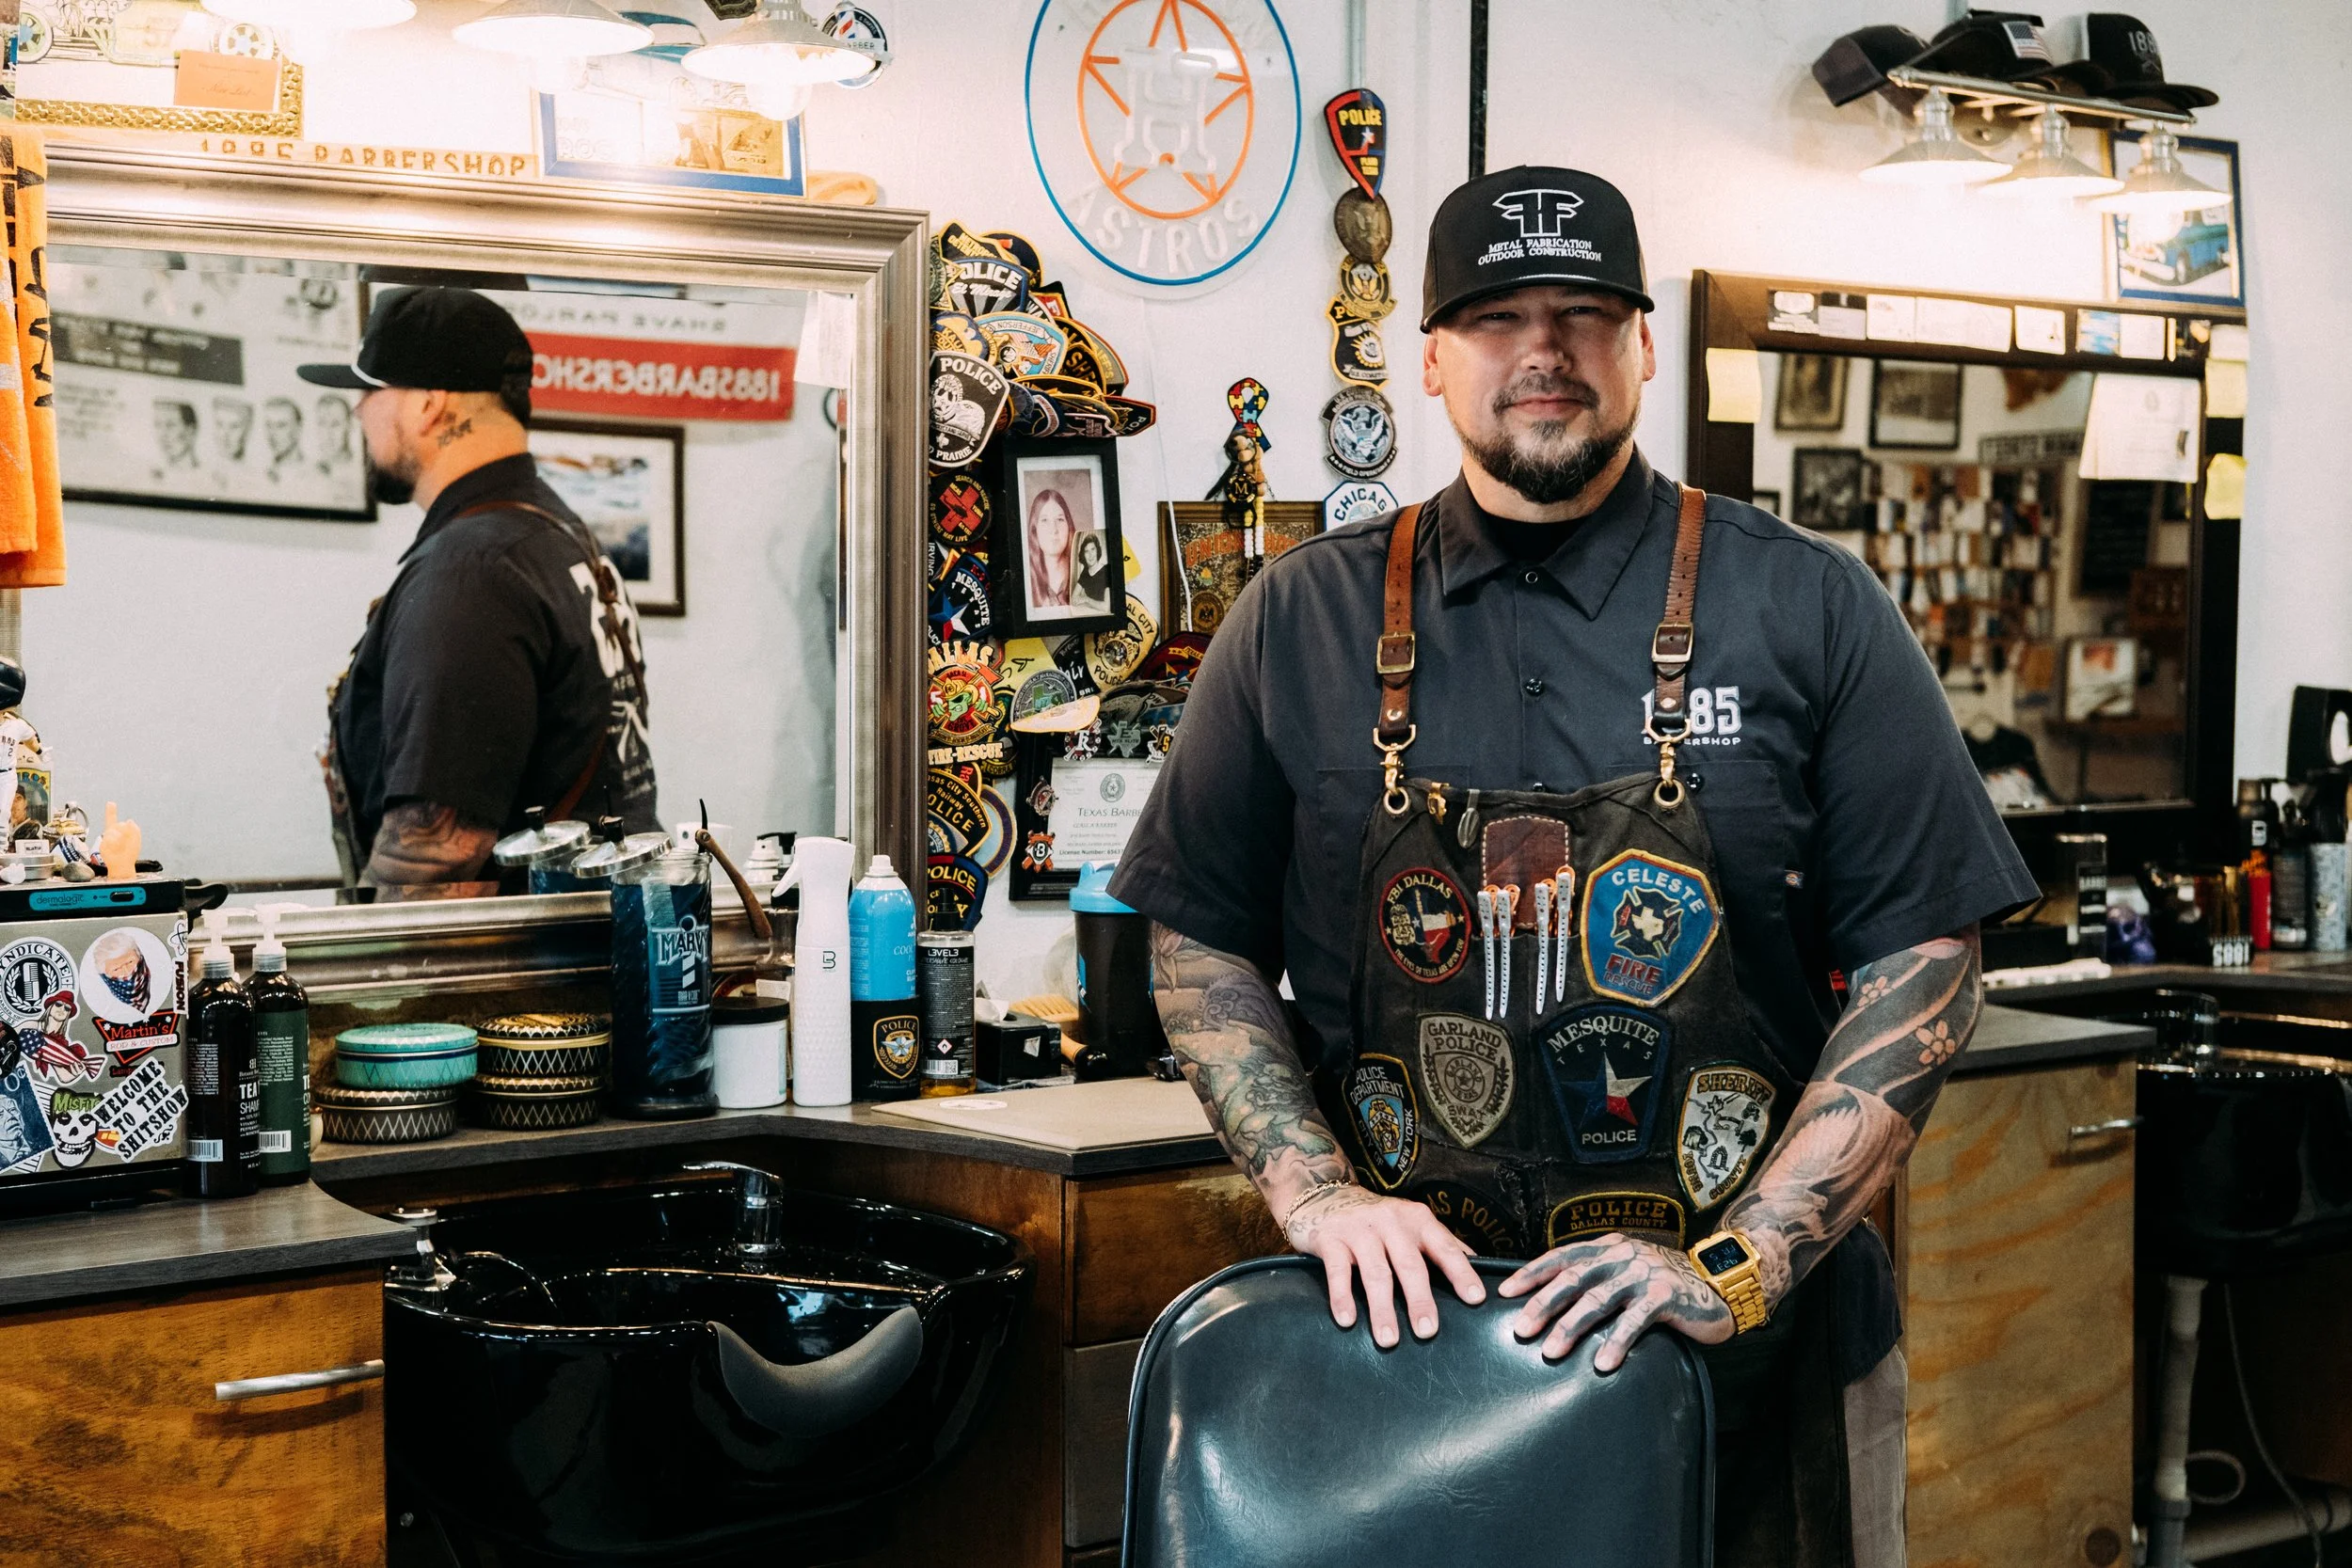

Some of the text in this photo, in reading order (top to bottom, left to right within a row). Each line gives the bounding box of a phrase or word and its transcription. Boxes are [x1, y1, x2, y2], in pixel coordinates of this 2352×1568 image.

[1338, 108, 1382, 126] POLICE
[1478, 247, 1601, 265] OUTDOOR CONSTRUCTION
[1488, 238, 1592, 253] METAL FABRICATION
[960, 262, 1023, 291] OLICE
[997, 321, 1041, 335] JEFFERSON
[940, 357, 1002, 395] POLICE
[936, 446, 972, 461] PRAIRIE
[1234, 482, 1248, 494] M
[1334, 488, 1388, 522] CHICAG
[956, 572, 990, 626] MESQUITE
[1137, 612, 1155, 635] CITY
[928, 641, 994, 674] ALLAS
[1094, 665, 1123, 687] POLICE
[1641, 686, 1742, 736] 185
[936, 786, 964, 810] Railway
[946, 781, 962, 795] City
[961, 793, 986, 828] Southern
[928, 794, 975, 832] OLICE
[1111, 808, 1143, 816] BARBE
[1387, 874, 1453, 904] FBI DALLAS
[1612, 868, 1706, 915] CELESTE
[0, 944, 72, 976] YNDICATE
[1605, 953, 1664, 986] FIRE
[175, 960, 185, 1011] FUSION
[1604, 972, 1654, 996] RESCUE
[110, 1022, 169, 1039] Martin's
[881, 1020, 918, 1034] POLICE
[1427, 1022, 1502, 1049] GARLAND
[1547, 1015, 1660, 1053] MESQUITE
[110, 1041, 129, 1050] ROD
[140, 1037, 174, 1046] CUSTOM
[1433, 1037, 1499, 1062] POLICE
[1556, 1038, 1653, 1066] TEXAS
[1355, 1066, 1387, 1084] POLICE
[1445, 1059, 1483, 1083] GARLAND
[96, 1060, 162, 1123] WELCOME
[137, 1080, 170, 1112] THE
[1349, 1083, 1406, 1106] DEPARTMENT
[1697, 1072, 1772, 1106] SHERIFF
[112, 1110, 137, 1135] TO
[118, 1086, 189, 1162] SHITSHOW
[1447, 1104, 1486, 1121] SWAT
[1397, 1108, 1414, 1172] NEW YORK
[1581, 1129, 1637, 1145] POLICE
[1708, 1153, 1747, 1200] COUNTY
[1570, 1200, 1668, 1221] POLICE
[1570, 1216, 1667, 1231] DALLAS COUNTY
